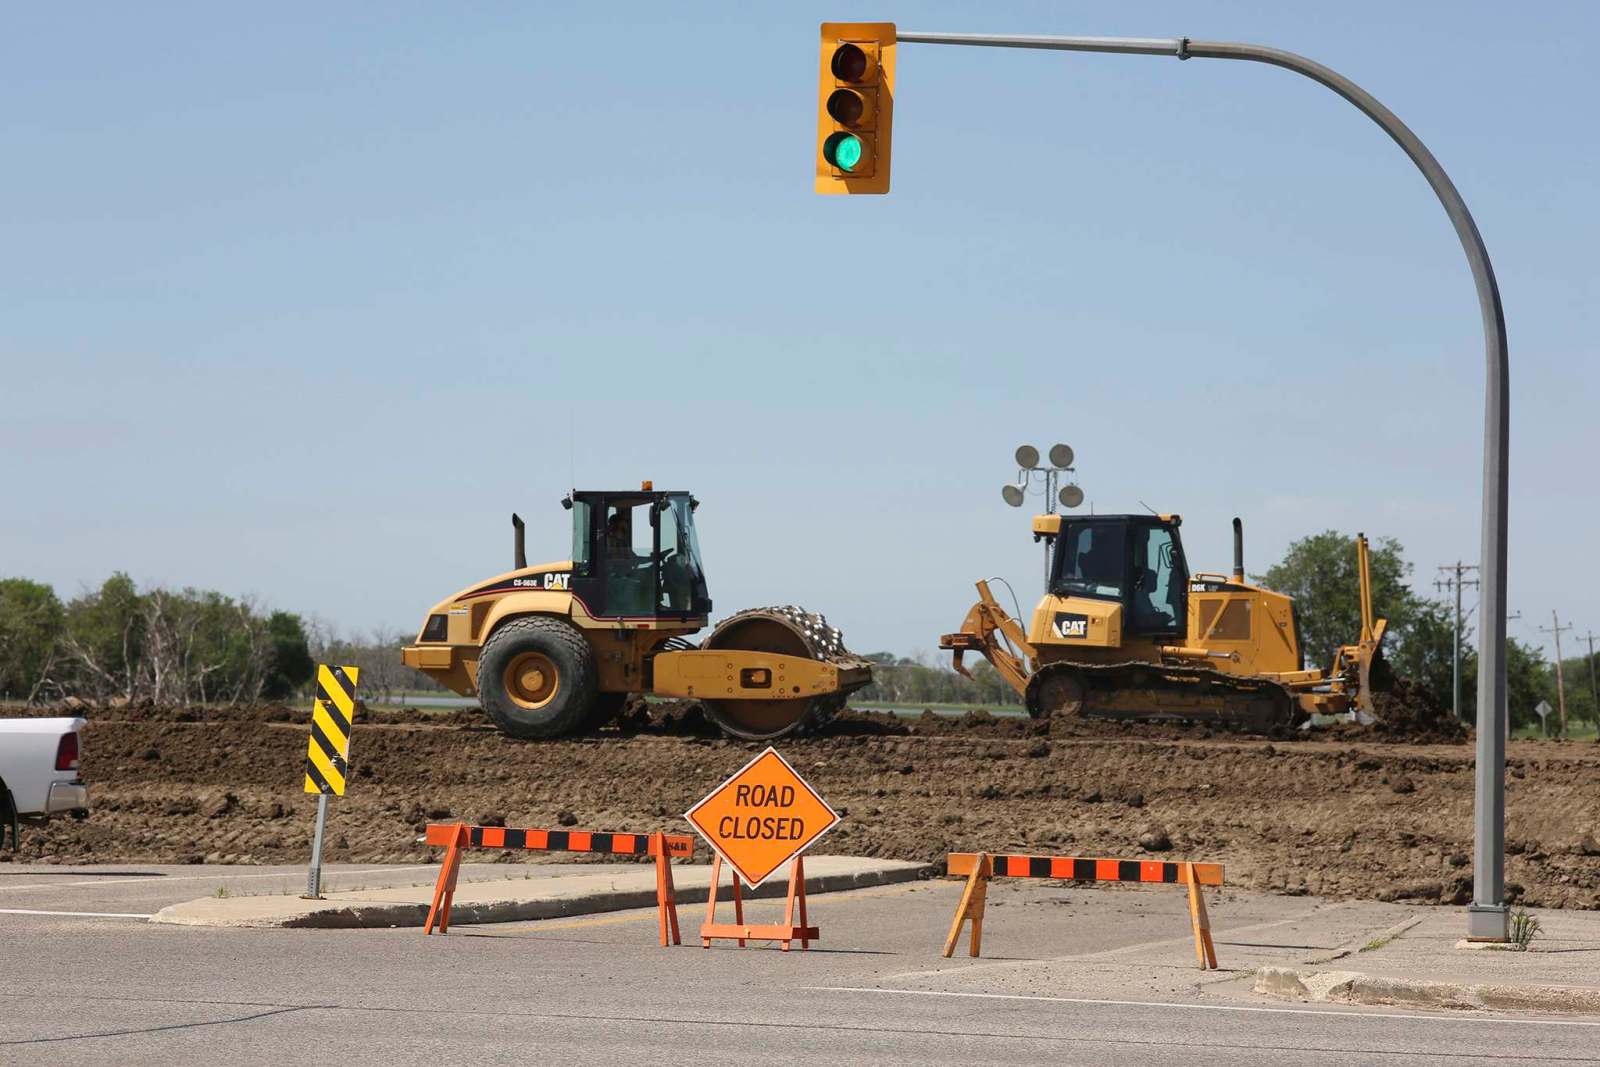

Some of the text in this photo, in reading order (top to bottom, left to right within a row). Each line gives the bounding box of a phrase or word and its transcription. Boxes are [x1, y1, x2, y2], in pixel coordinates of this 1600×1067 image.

[544, 573, 570, 590] CAT
[1062, 620, 1086, 636] CAT
[735, 784, 795, 807] ROAD
[718, 816, 804, 840] CLOSED
